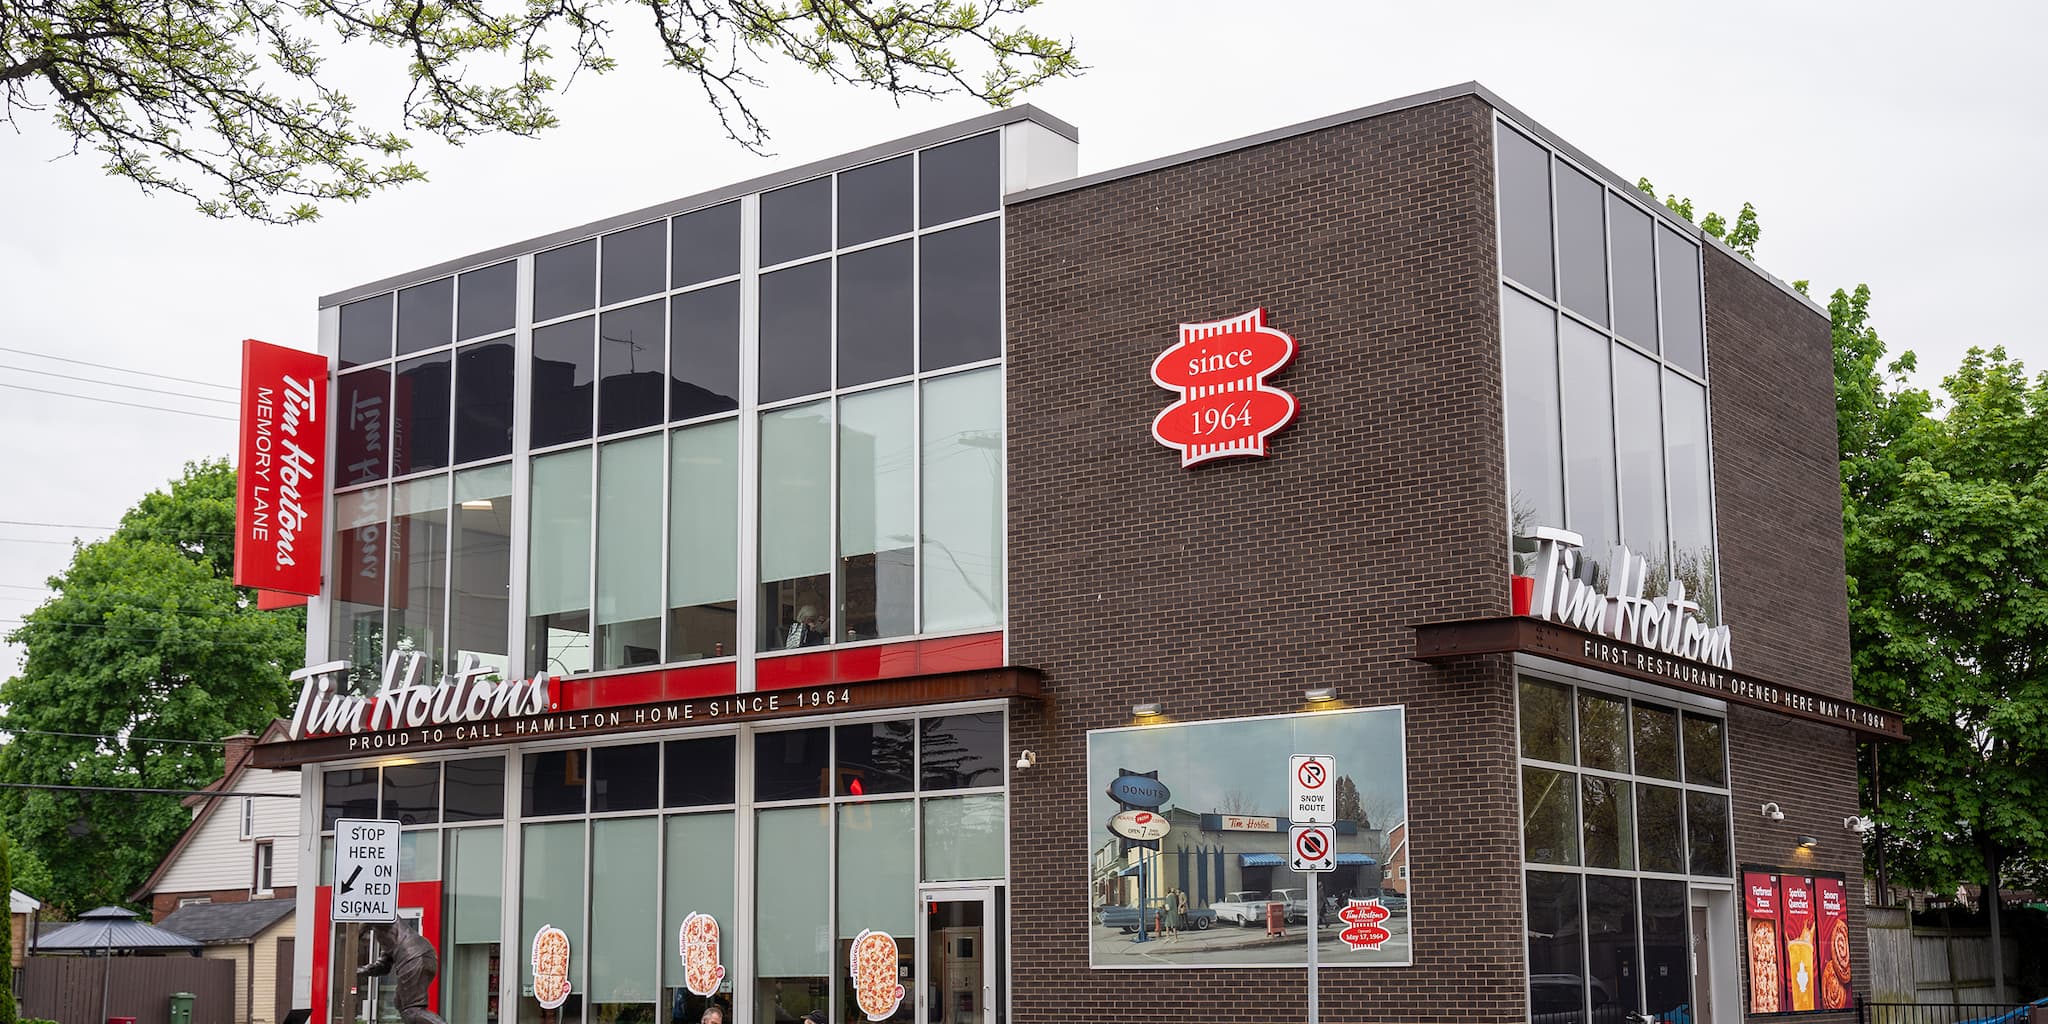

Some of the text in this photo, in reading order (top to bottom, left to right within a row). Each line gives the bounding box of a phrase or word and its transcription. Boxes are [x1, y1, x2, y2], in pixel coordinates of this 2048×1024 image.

[1188, 348, 1253, 376] since
[1191, 399, 1252, 436] 1964
[253, 387, 273, 541] MEMORY LANE
[276, 374, 316, 567] Tim Hortons
[1527, 526, 1733, 671] Tim Hortons
[1584, 640, 1885, 729] FIRST RESTAURANT OPENED HERE MAY 17, 1964
[289, 650, 549, 740] Tim Hortons
[349, 689, 850, 750] PROUD TO CALL HAMILTON HOME SINCE 1964
[1122, 785, 1164, 798] DONUTS
[1300, 795, 1324, 803] SNOW
[1299, 804, 1326, 812] ROUTE
[351, 828, 385, 841] STOP
[1141, 826, 1147, 838] 7
[349, 846, 385, 859] HERE
[374, 864, 392, 878] ON
[364, 883, 391, 896] RED
[340, 901, 389, 915] SIGNAL
